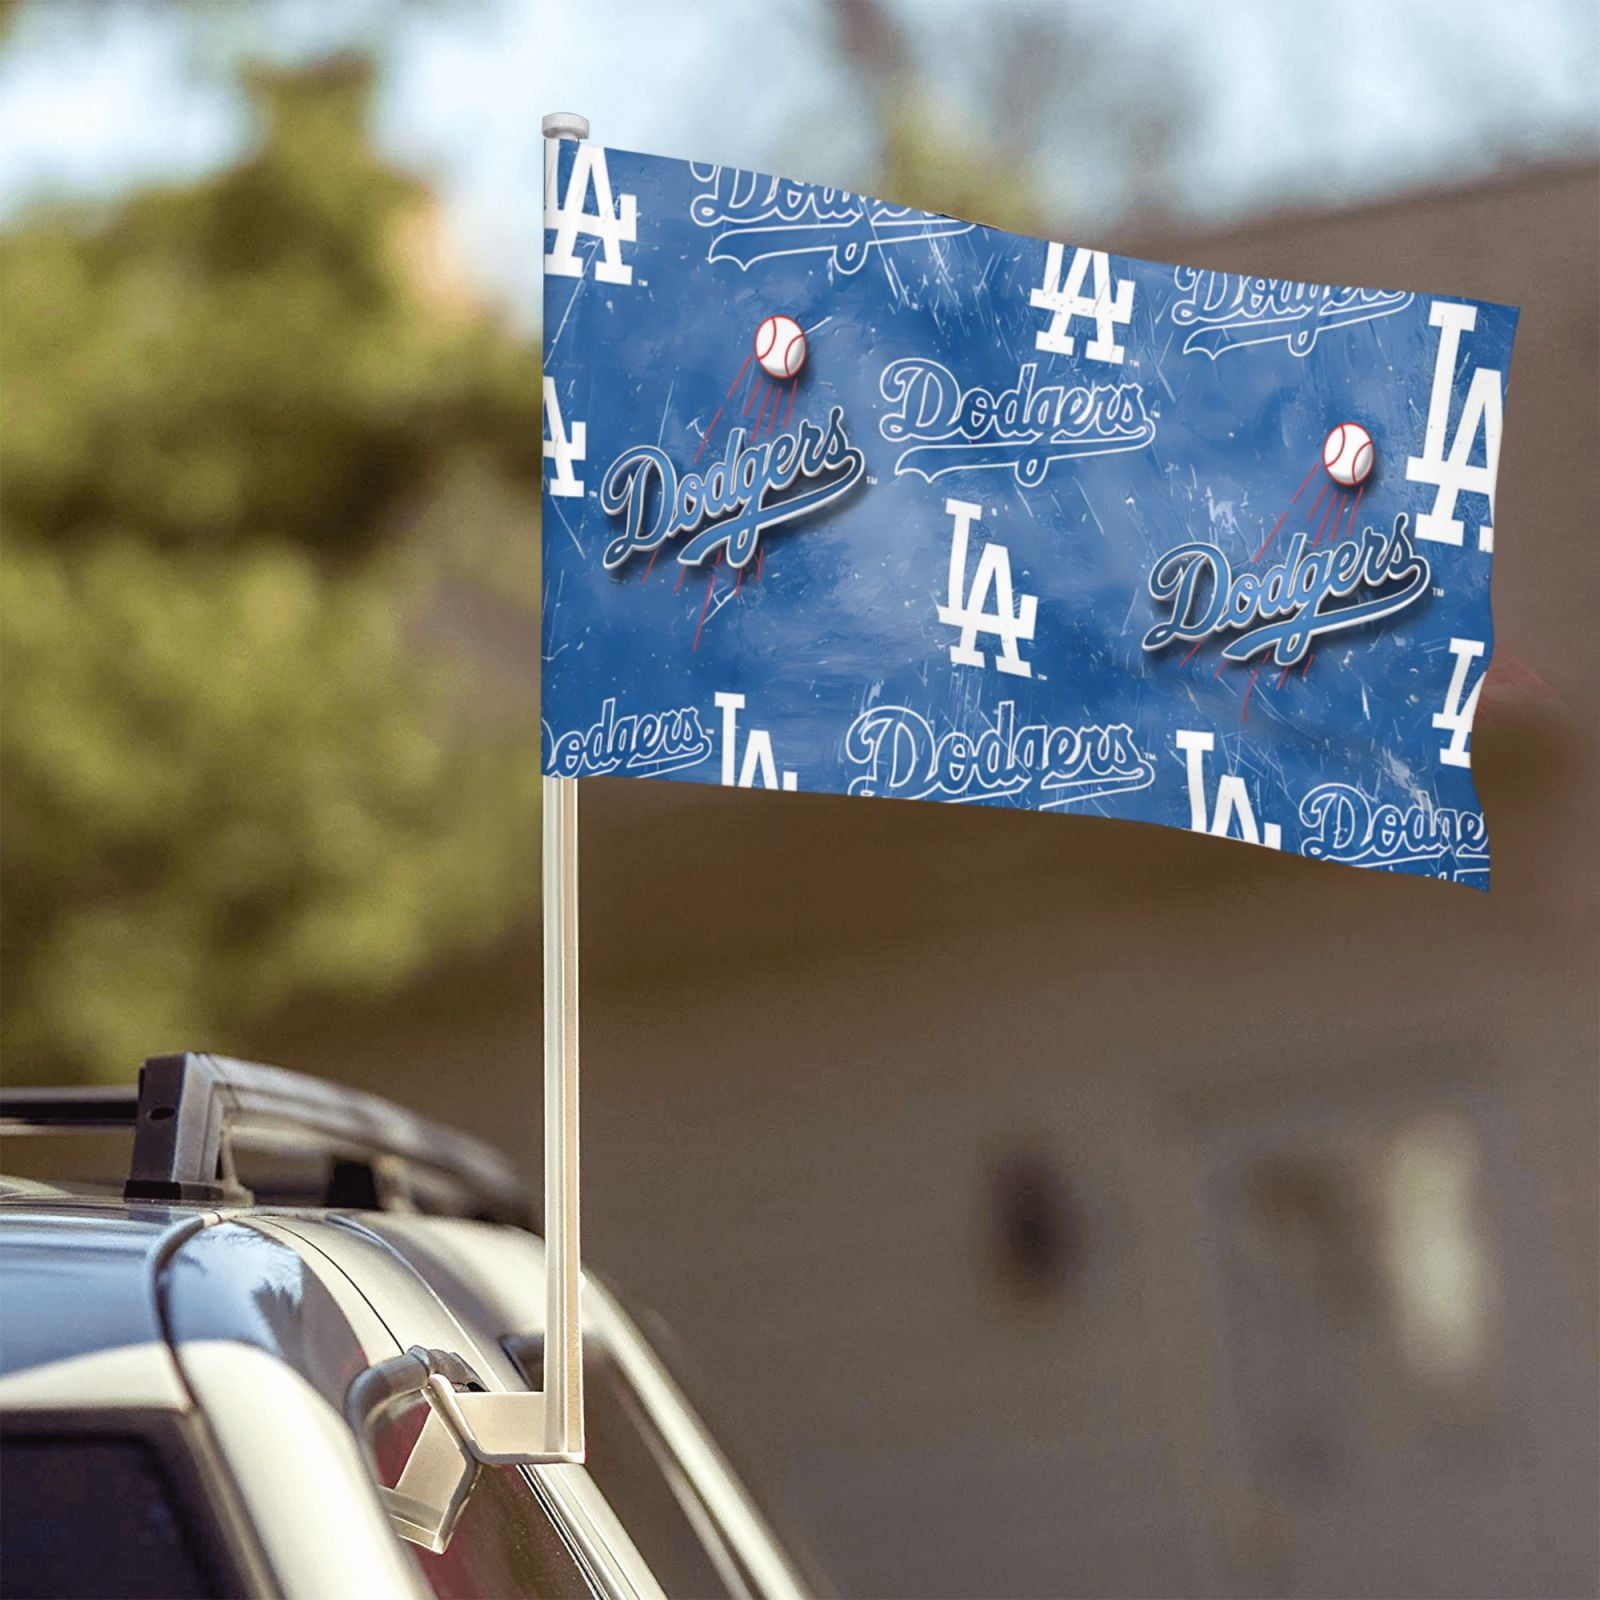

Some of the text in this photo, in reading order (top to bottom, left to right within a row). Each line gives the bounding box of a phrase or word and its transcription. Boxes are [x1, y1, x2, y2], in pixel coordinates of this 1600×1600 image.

[1030, 241, 1136, 364] LA
[879, 357, 1157, 487] Dodgers
[600, 406, 866, 569] Dodgers
[935, 498, 1038, 677] LA
[1141, 512, 1431, 667] Dodgers
[542, 697, 712, 778] odgers
[846, 700, 1156, 812] Dodgers
[1299, 782, 1491, 882] Dodge
